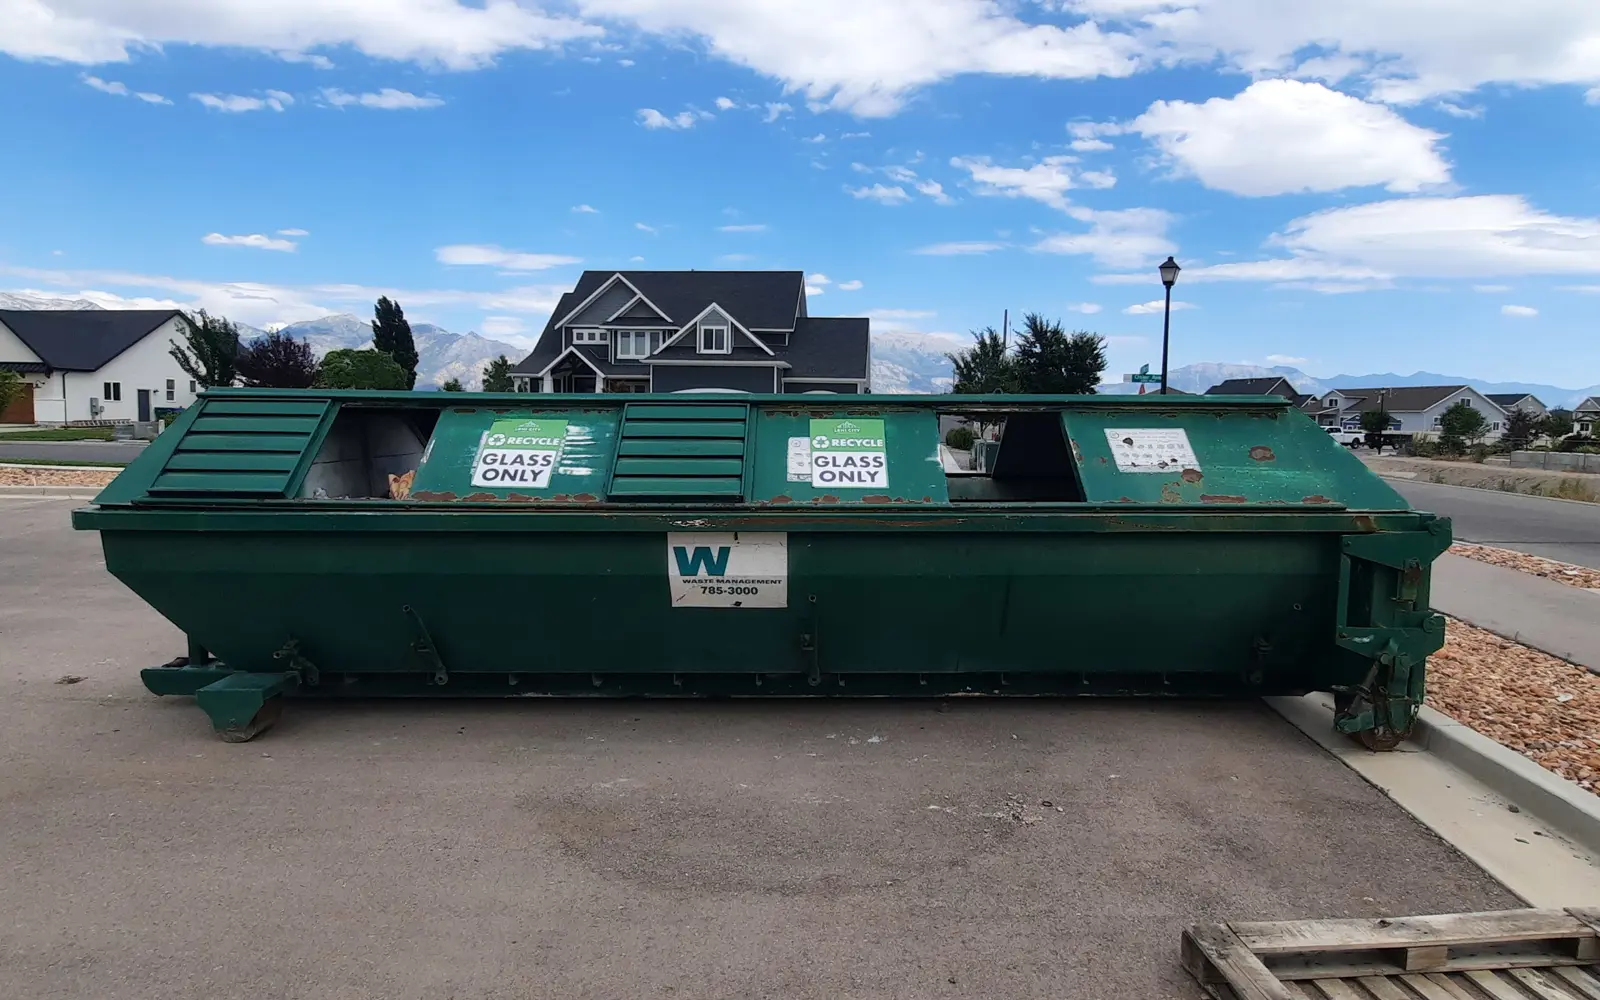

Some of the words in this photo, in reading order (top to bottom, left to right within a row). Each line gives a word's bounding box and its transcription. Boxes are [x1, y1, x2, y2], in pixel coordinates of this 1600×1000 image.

[507, 436, 560, 446] RECYCLE
[831, 438, 884, 447] RECYCLE
[482, 453, 553, 467] GLASS
[814, 455, 884, 468] GLASS
[482, 468, 544, 482] ONLY
[819, 470, 879, 483] ONLY
[700, 586, 758, 595] 785-3000
